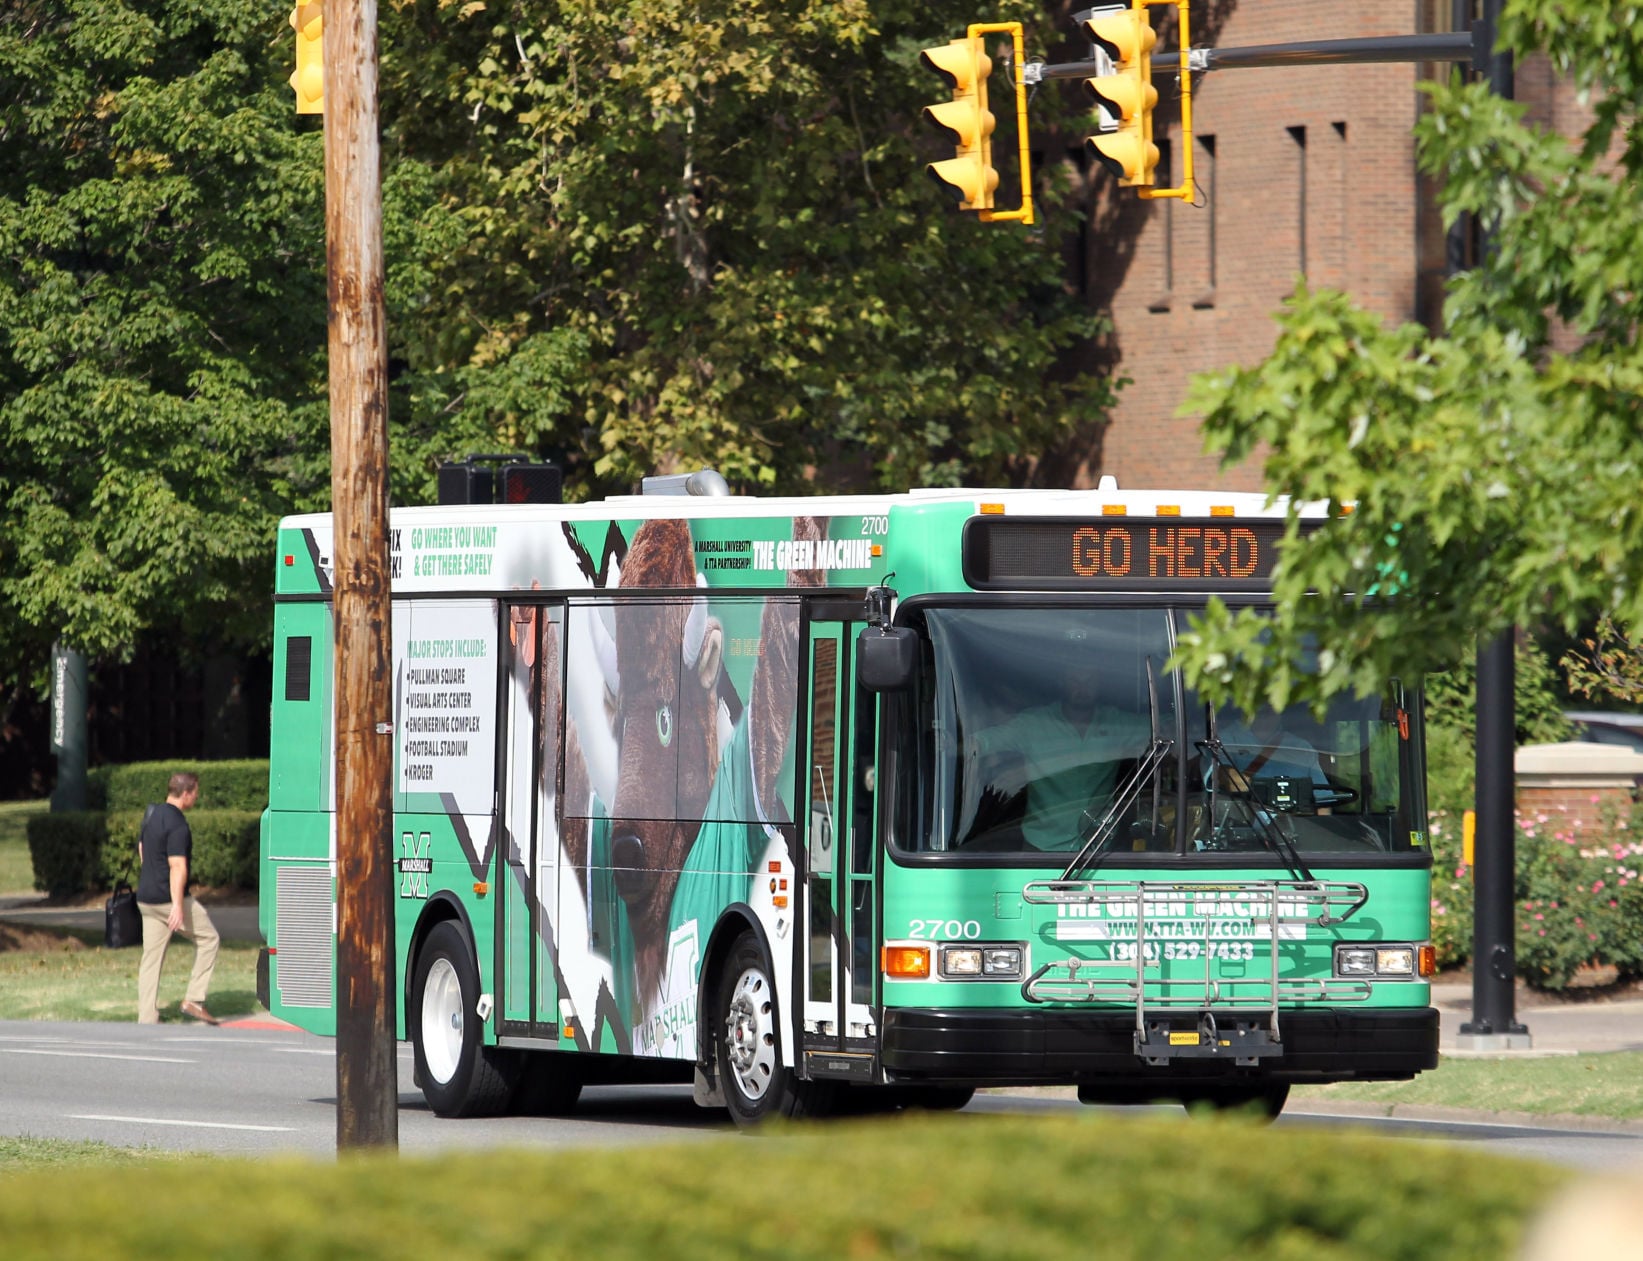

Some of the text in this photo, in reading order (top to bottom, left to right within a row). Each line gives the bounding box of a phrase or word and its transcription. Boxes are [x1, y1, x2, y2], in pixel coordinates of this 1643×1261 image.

[860, 517, 888, 535] 2700
[411, 526, 497, 549] GO WHERE YOU WANT
[699, 540, 724, 553] MARSHALL
[724, 540, 752, 553] UNIVERSITY
[753, 539, 872, 571] THE GREEN MACHINE
[1072, 527, 1258, 577] GO HERD
[414, 555, 420, 577] &
[422, 555, 437, 576] GET
[437, 554, 462, 576] THERE
[464, 553, 493, 575] SAFELY
[708, 557, 717, 570] TTA
[407, 638, 487, 659] MAJOR STOPS INCLUDE:
[410, 668, 465, 685] PULLMAN SQUARE
[409, 692, 472, 709] VISUAL ARTS CENTER
[409, 716, 480, 733] ENGINEERING COMPLEX
[409, 741, 468, 757] FOOTBALL STADIUM
[408, 764, 434, 781] KROGER
[401, 858, 430, 873] MARSHALL
[1055, 891, 1309, 918] THE GREEN MACHINE
[908, 919, 981, 940] 2700
[1107, 921, 1256, 937] WWW.TTA-WV.COM
[1109, 941, 1254, 961] (304) 529-7433
